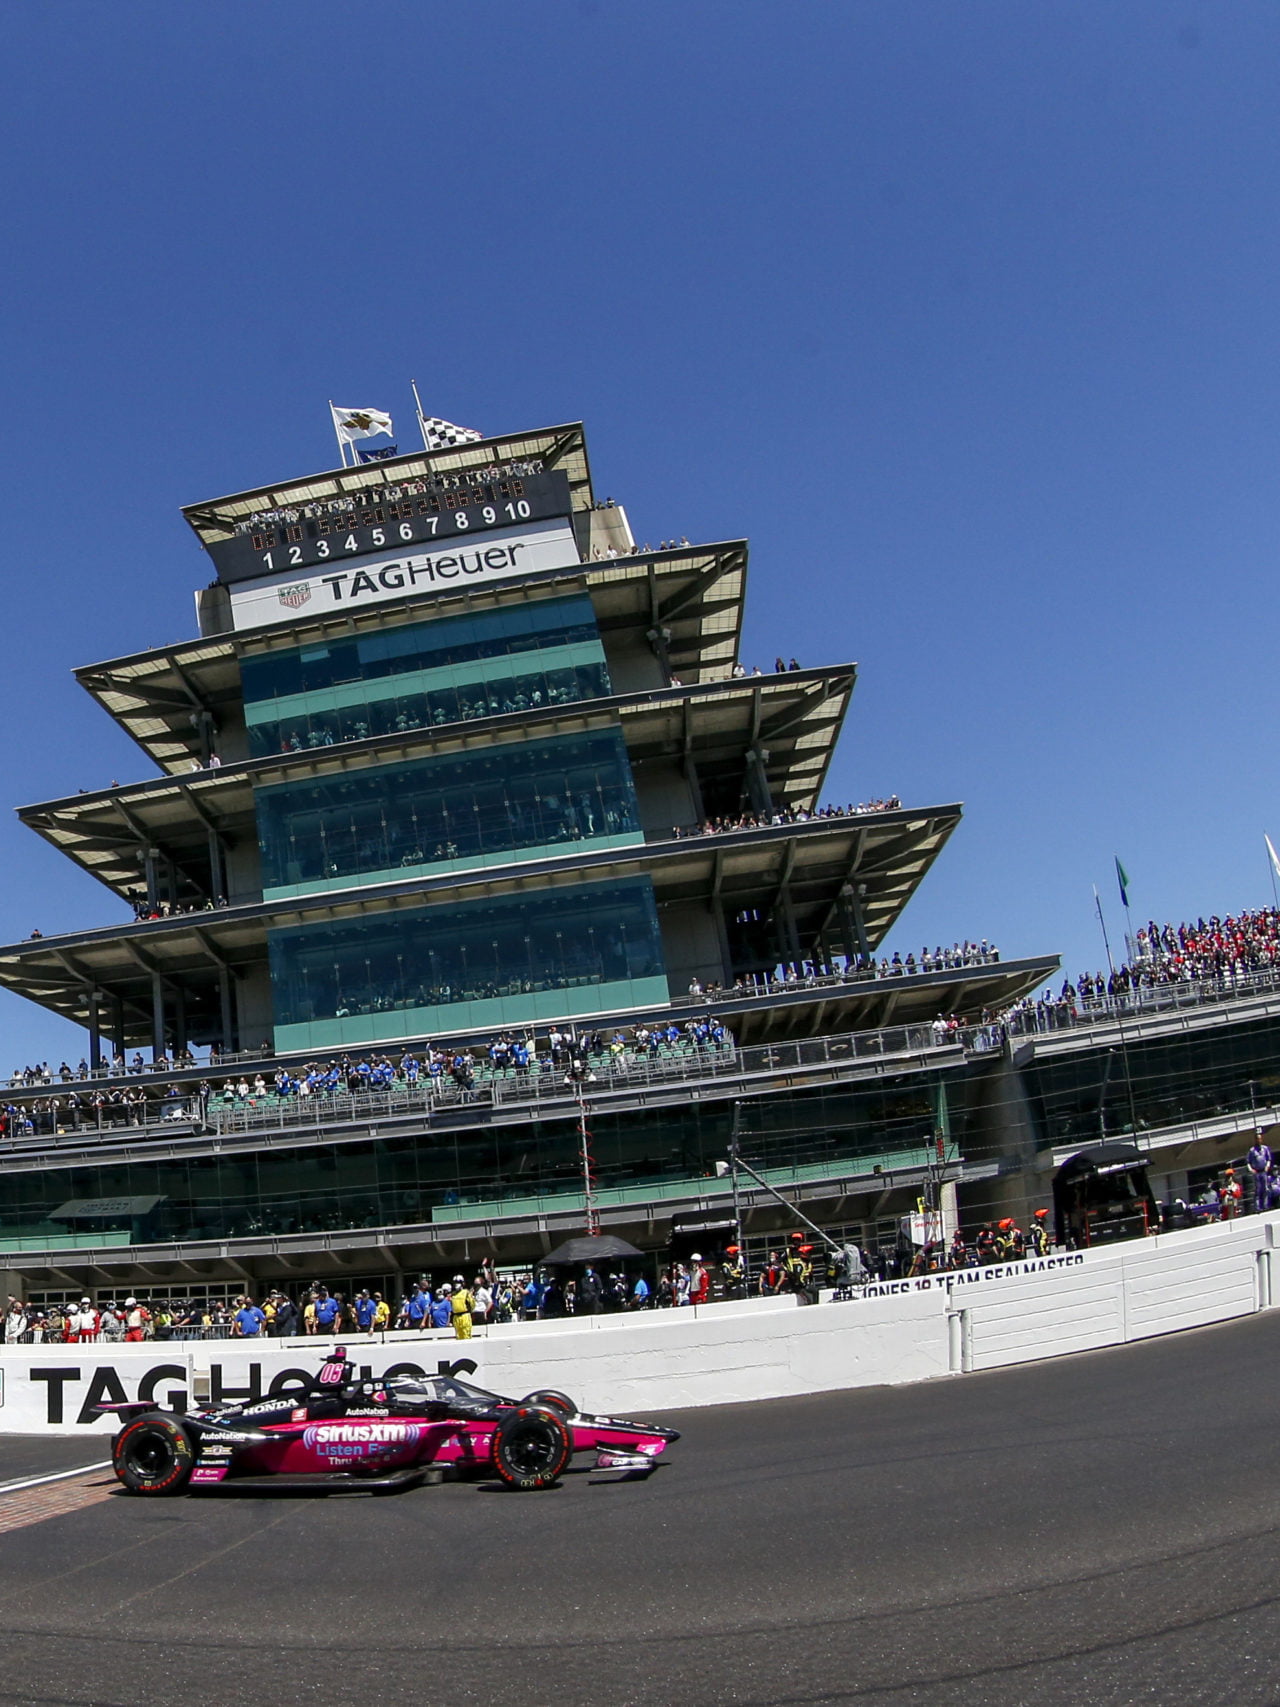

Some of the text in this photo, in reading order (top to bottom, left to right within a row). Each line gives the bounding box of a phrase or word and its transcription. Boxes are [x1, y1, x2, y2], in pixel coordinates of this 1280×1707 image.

[263, 500, 531, 569] 1 2 3 4 5 6 7 8 9 10
[320, 1363, 345, 1383] 06
[242, 1398, 300, 1416] HONDA
[345, 1408, 389, 1416] AutoNation
[200, 1432, 246, 1441] AutoNation
[316, 1443, 363, 1456] Listen
[328, 1456, 352, 1465] Thru
